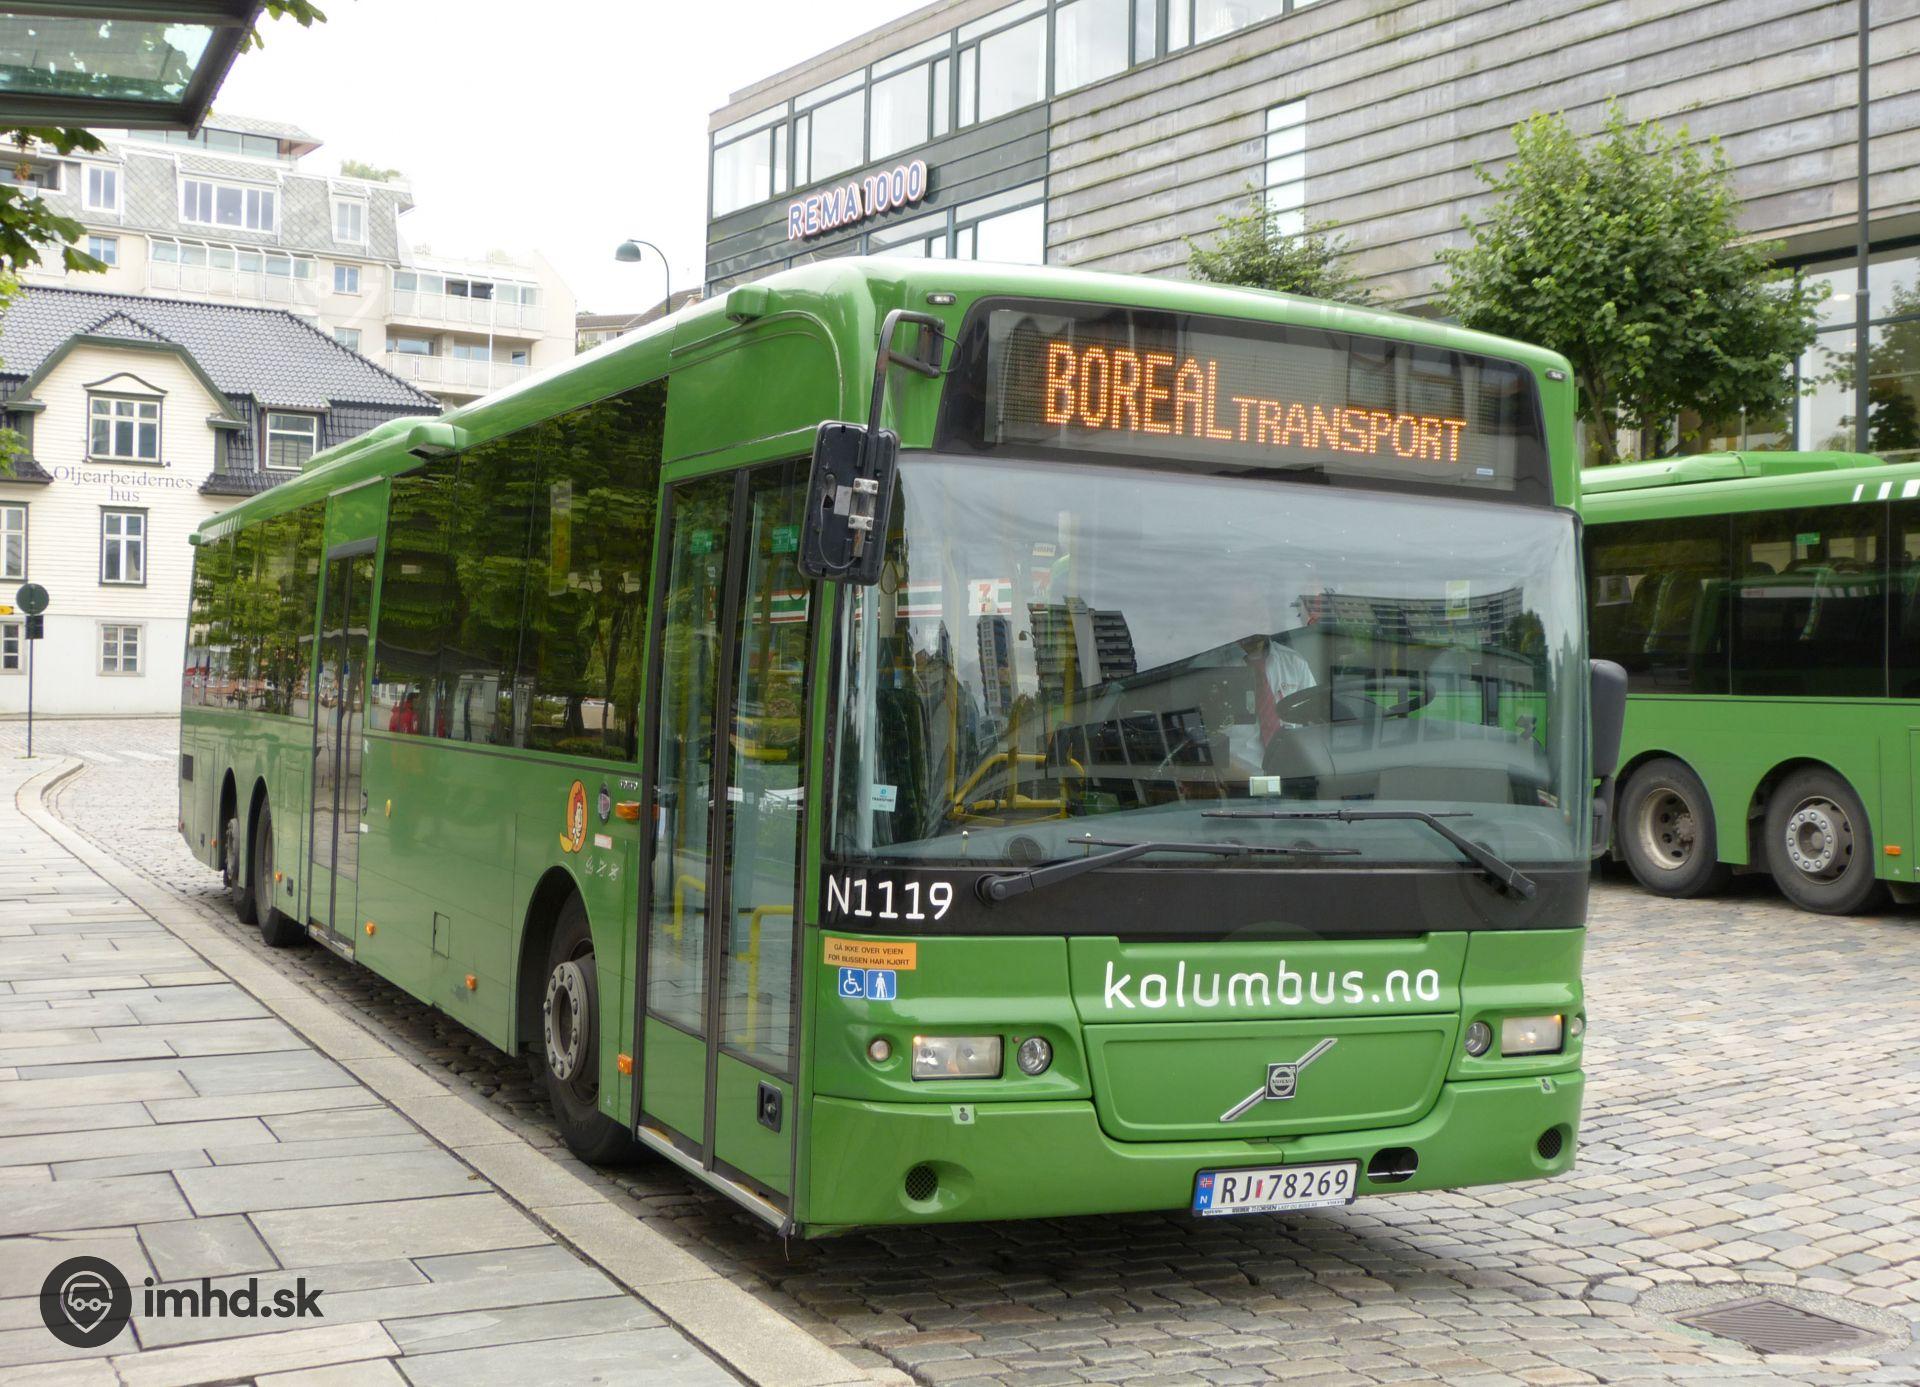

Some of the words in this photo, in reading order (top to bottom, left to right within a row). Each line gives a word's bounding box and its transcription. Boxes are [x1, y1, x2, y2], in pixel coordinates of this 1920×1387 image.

[788, 182, 863, 240] REMA
[863, 159, 927, 216] 1000
[1045, 342, 1232, 440] BOREAL
[1231, 396, 1467, 462] TRANSPORT
[54, 465, 193, 488] Oljearbeidernes
[110, 486, 140, 502] hus
[827, 874, 953, 920] N1119
[841, 955, 868, 964] BUSSEN
[869, 957, 885, 965] HAR
[844, 944, 859, 952] IKKE
[861, 946, 880, 954] OVER
[1104, 959, 1440, 1009] kolumbus.no
[1200, 1195, 1208, 1204] N
[1221, 1175, 1253, 1204] RJ
[1268, 1169, 1349, 1201] 78269
